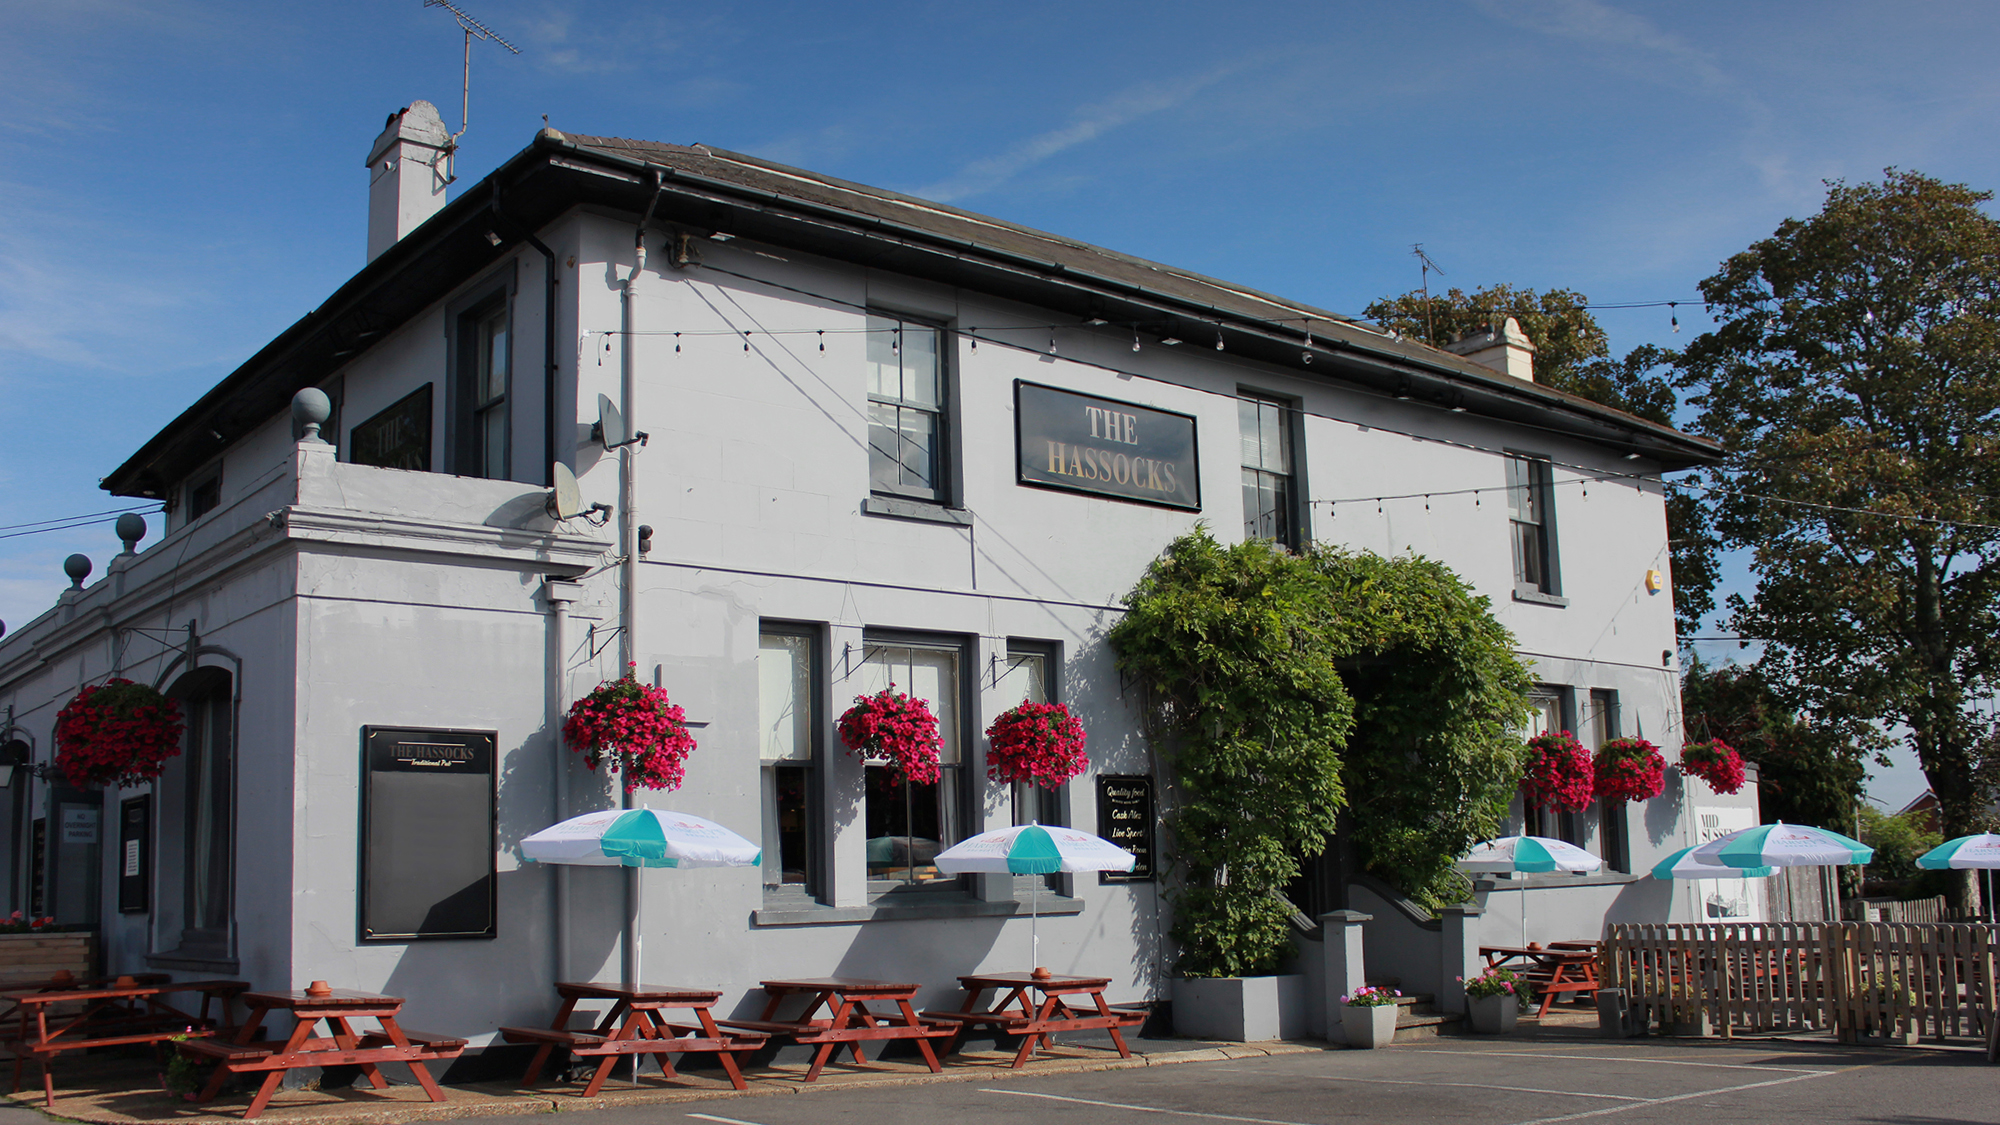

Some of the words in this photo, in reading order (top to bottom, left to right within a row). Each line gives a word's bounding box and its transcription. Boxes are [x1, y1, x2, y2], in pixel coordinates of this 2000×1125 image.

[1085, 405, 1138, 446] THE
[1047, 440, 1176, 493] HASSOCKS
[388, 744, 413, 758] THE
[416, 745, 475, 761] HASSOCKS
[410, 758, 441, 767] Traditional
[440, 759, 452, 767] Pub
[1106, 785, 1131, 799] Quality
[1131, 787, 1145, 799] food
[1700, 814, 1719, 828] MID
[1112, 827, 1125, 838] Live
[1125, 826, 1144, 840] Sport
